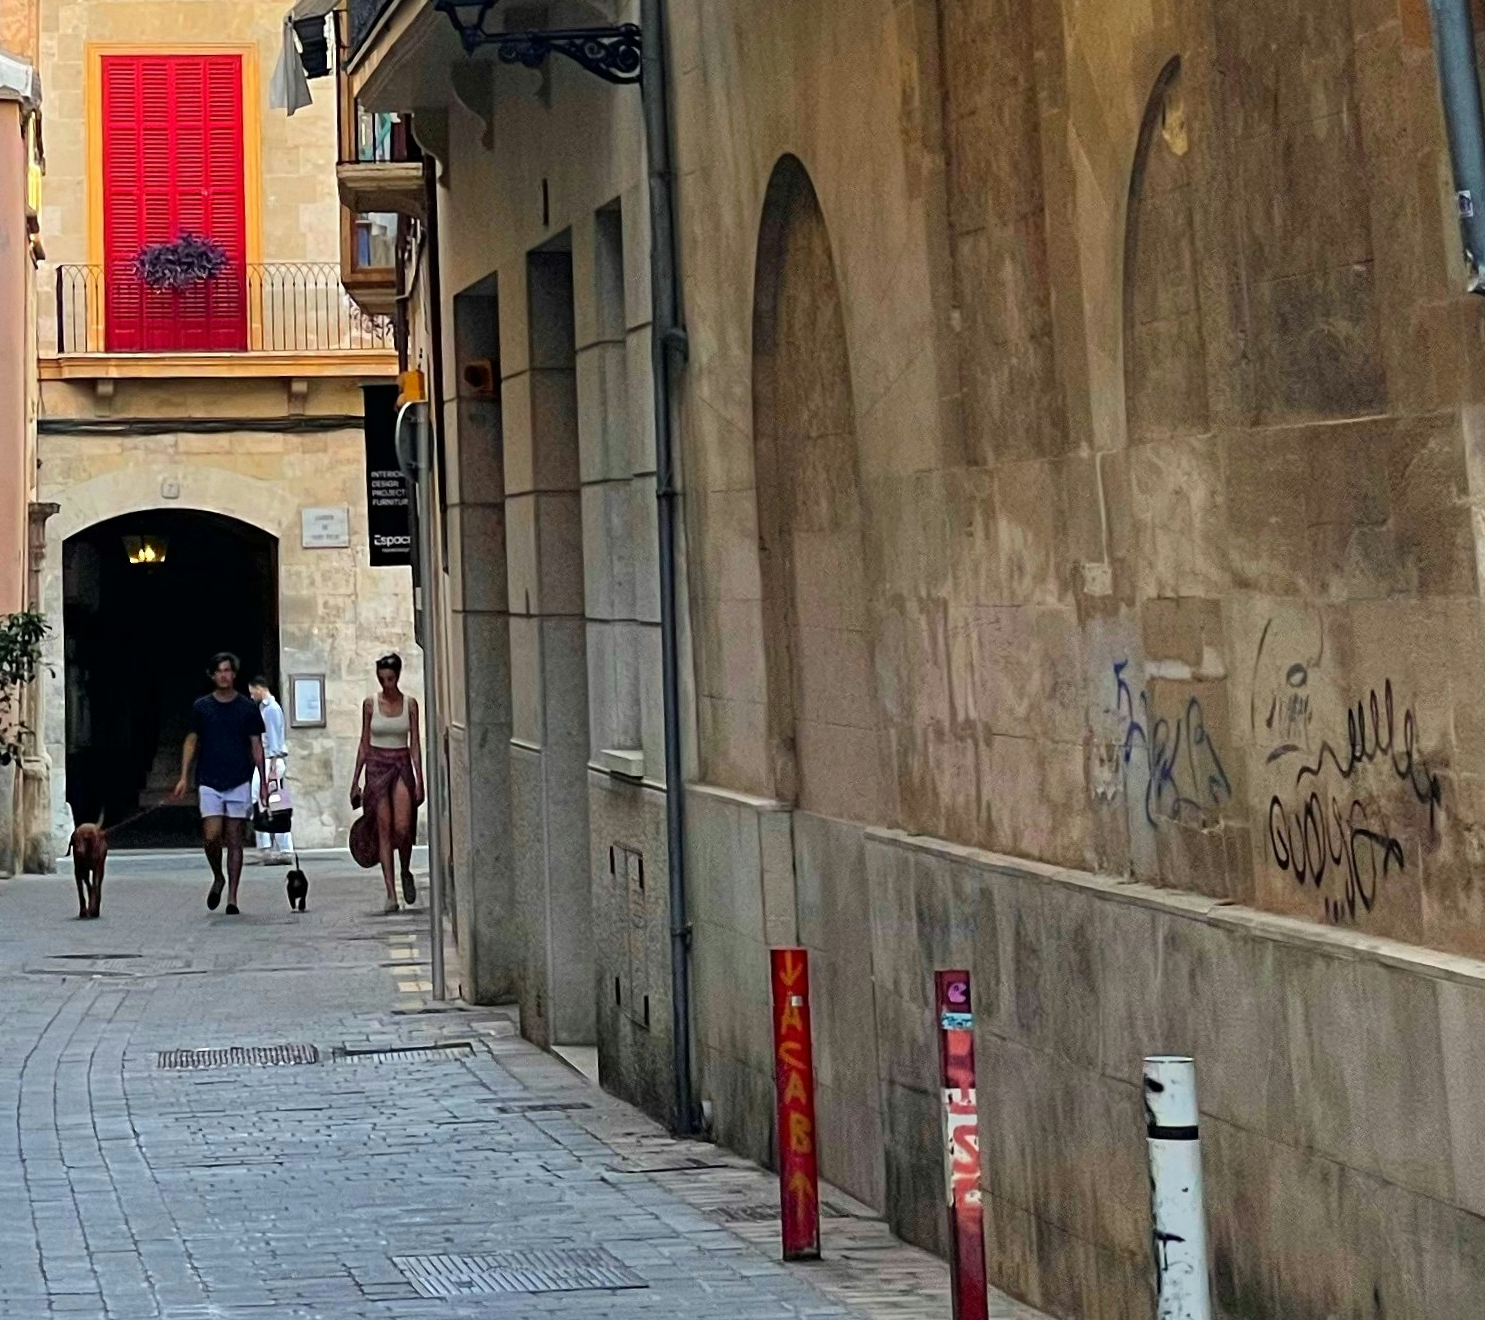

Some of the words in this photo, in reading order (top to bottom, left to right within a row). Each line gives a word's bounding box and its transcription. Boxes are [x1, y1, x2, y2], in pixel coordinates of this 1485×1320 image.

[372, 498, 408, 506] FURNITUR
[374, 534, 411, 547] Espaci
[778, 991, 813, 1154] ACAB
